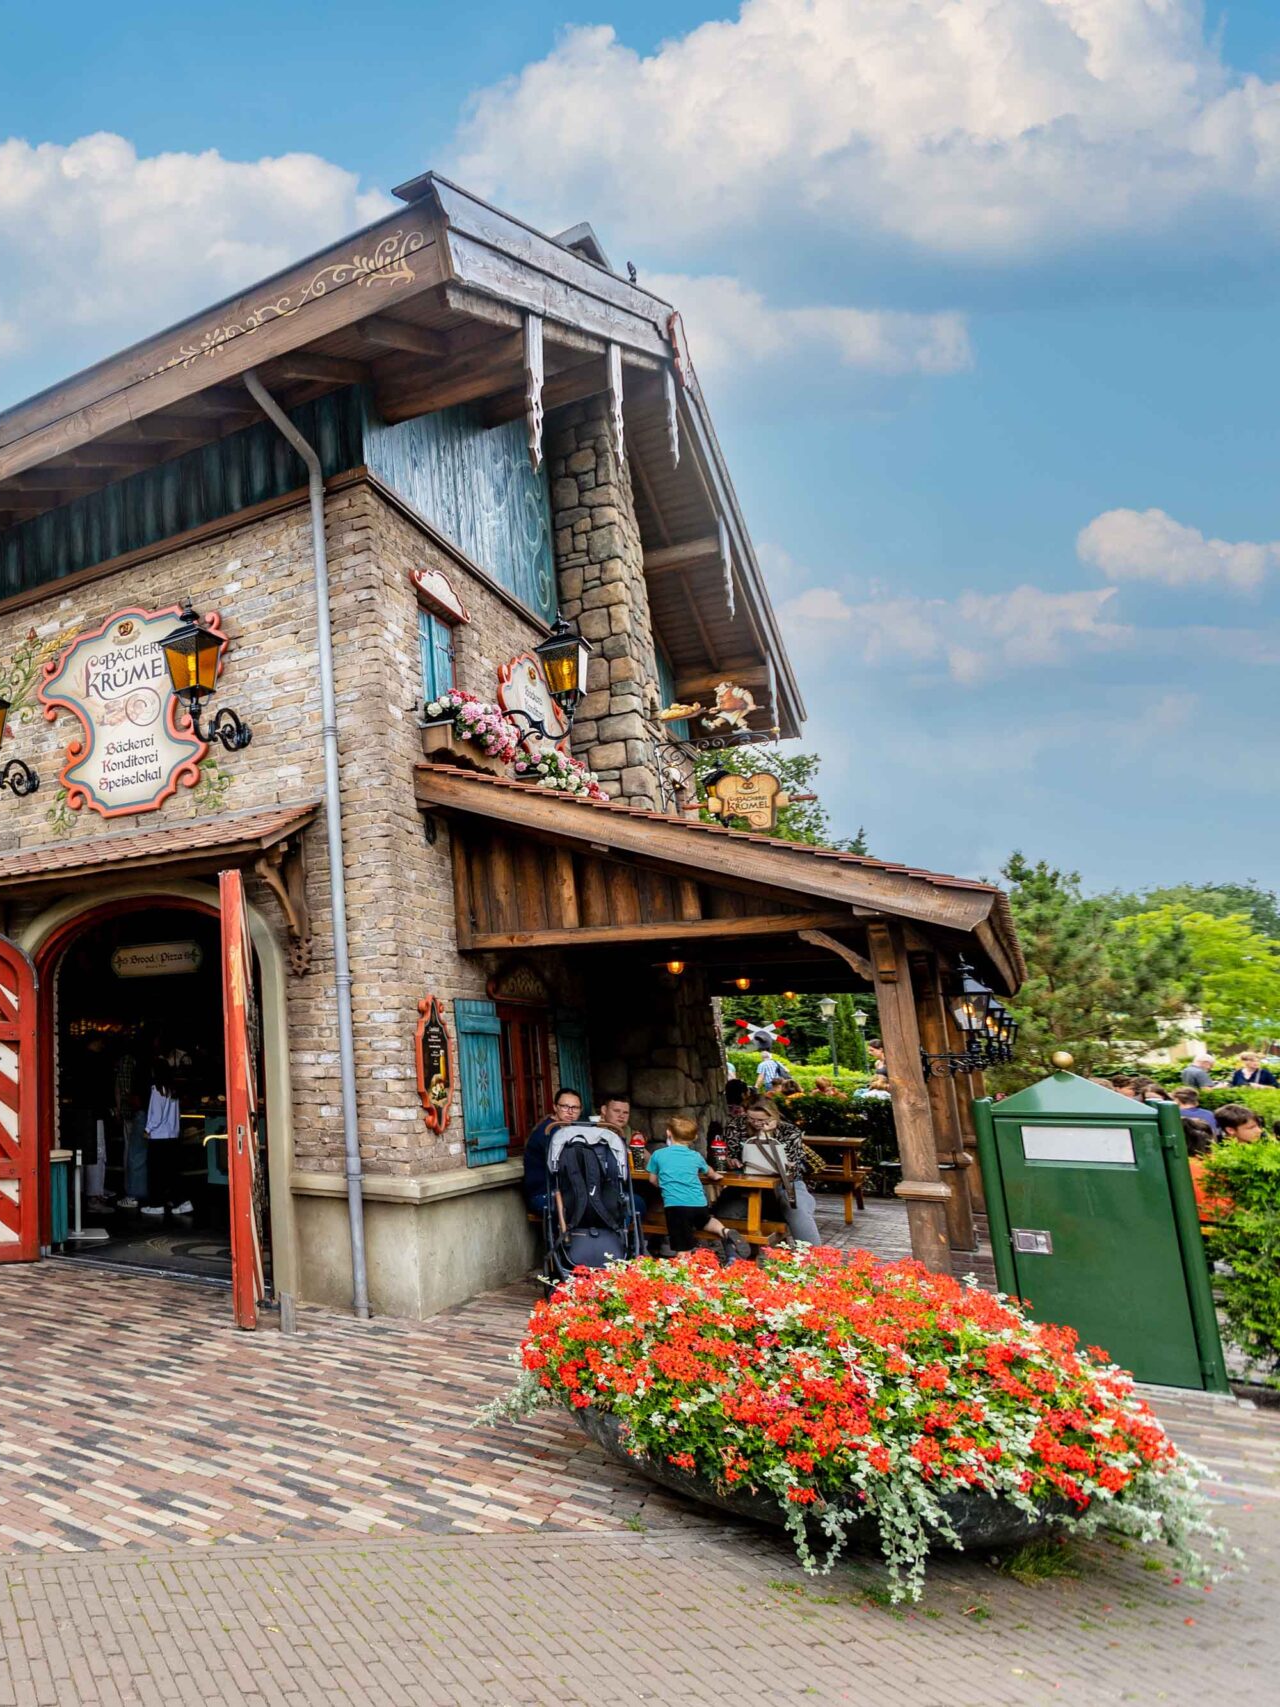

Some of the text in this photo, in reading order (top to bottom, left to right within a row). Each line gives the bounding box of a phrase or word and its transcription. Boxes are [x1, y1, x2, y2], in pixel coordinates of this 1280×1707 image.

[100, 643, 164, 671] BÄCKER
[104, 734, 154, 755] Bäckerei
[101, 750, 158, 773] Konditorei
[99, 766, 161, 792] Speiselokal
